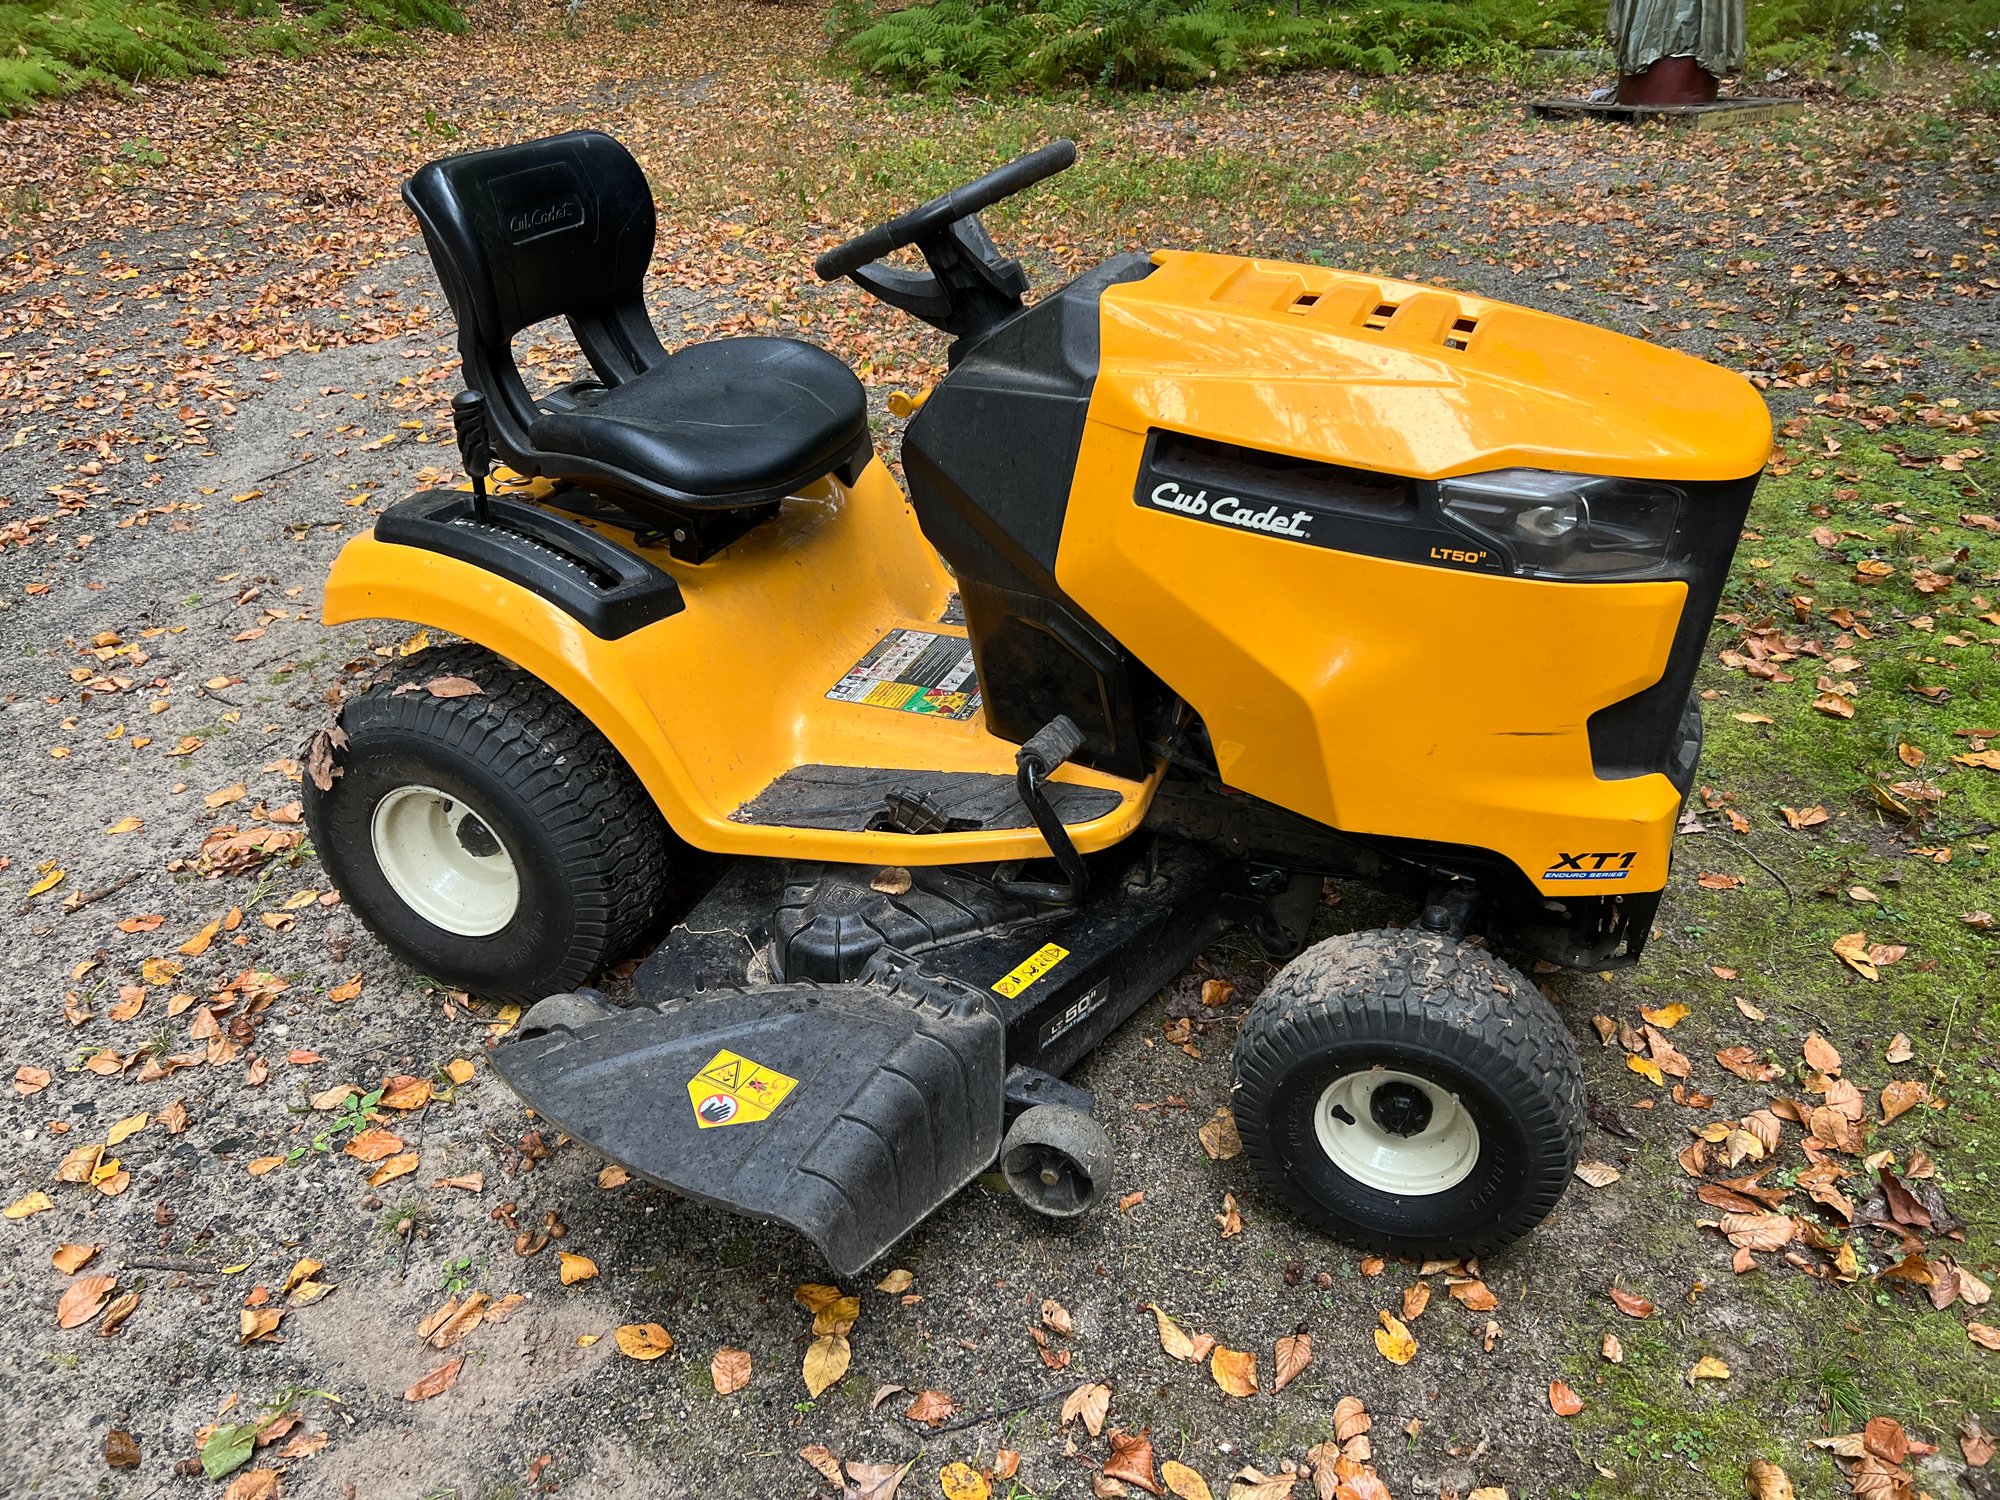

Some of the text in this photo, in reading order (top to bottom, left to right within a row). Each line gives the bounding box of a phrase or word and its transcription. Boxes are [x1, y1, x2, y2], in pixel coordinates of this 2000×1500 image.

[1151, 482, 1313, 537] Cub Cadet
[1430, 547, 1487, 564] LT50"
[1547, 851, 1638, 870] XT1
[1065, 989, 1097, 1024] 50"
